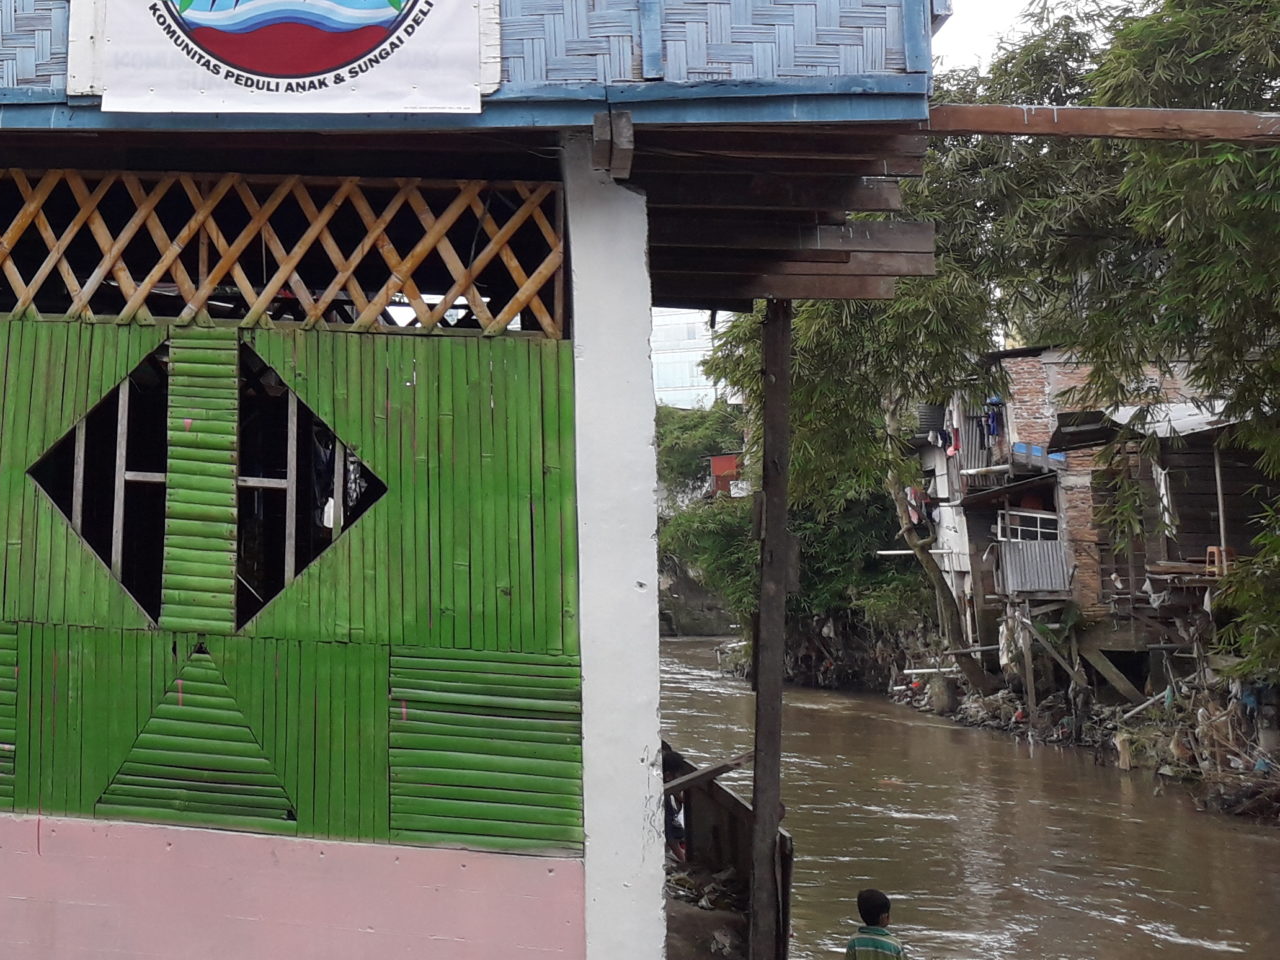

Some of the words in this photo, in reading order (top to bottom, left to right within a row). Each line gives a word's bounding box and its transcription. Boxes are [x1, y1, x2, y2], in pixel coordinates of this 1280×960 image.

[148, 2, 221, 75] KOMUNITAS
[224, 69, 280, 92] PEDULI
[284, 77, 329, 93] ANAK
[333, 72, 346, 85] &
[348, 35, 404, 78] SUNGAI
[403, 0, 434, 37] DELI
